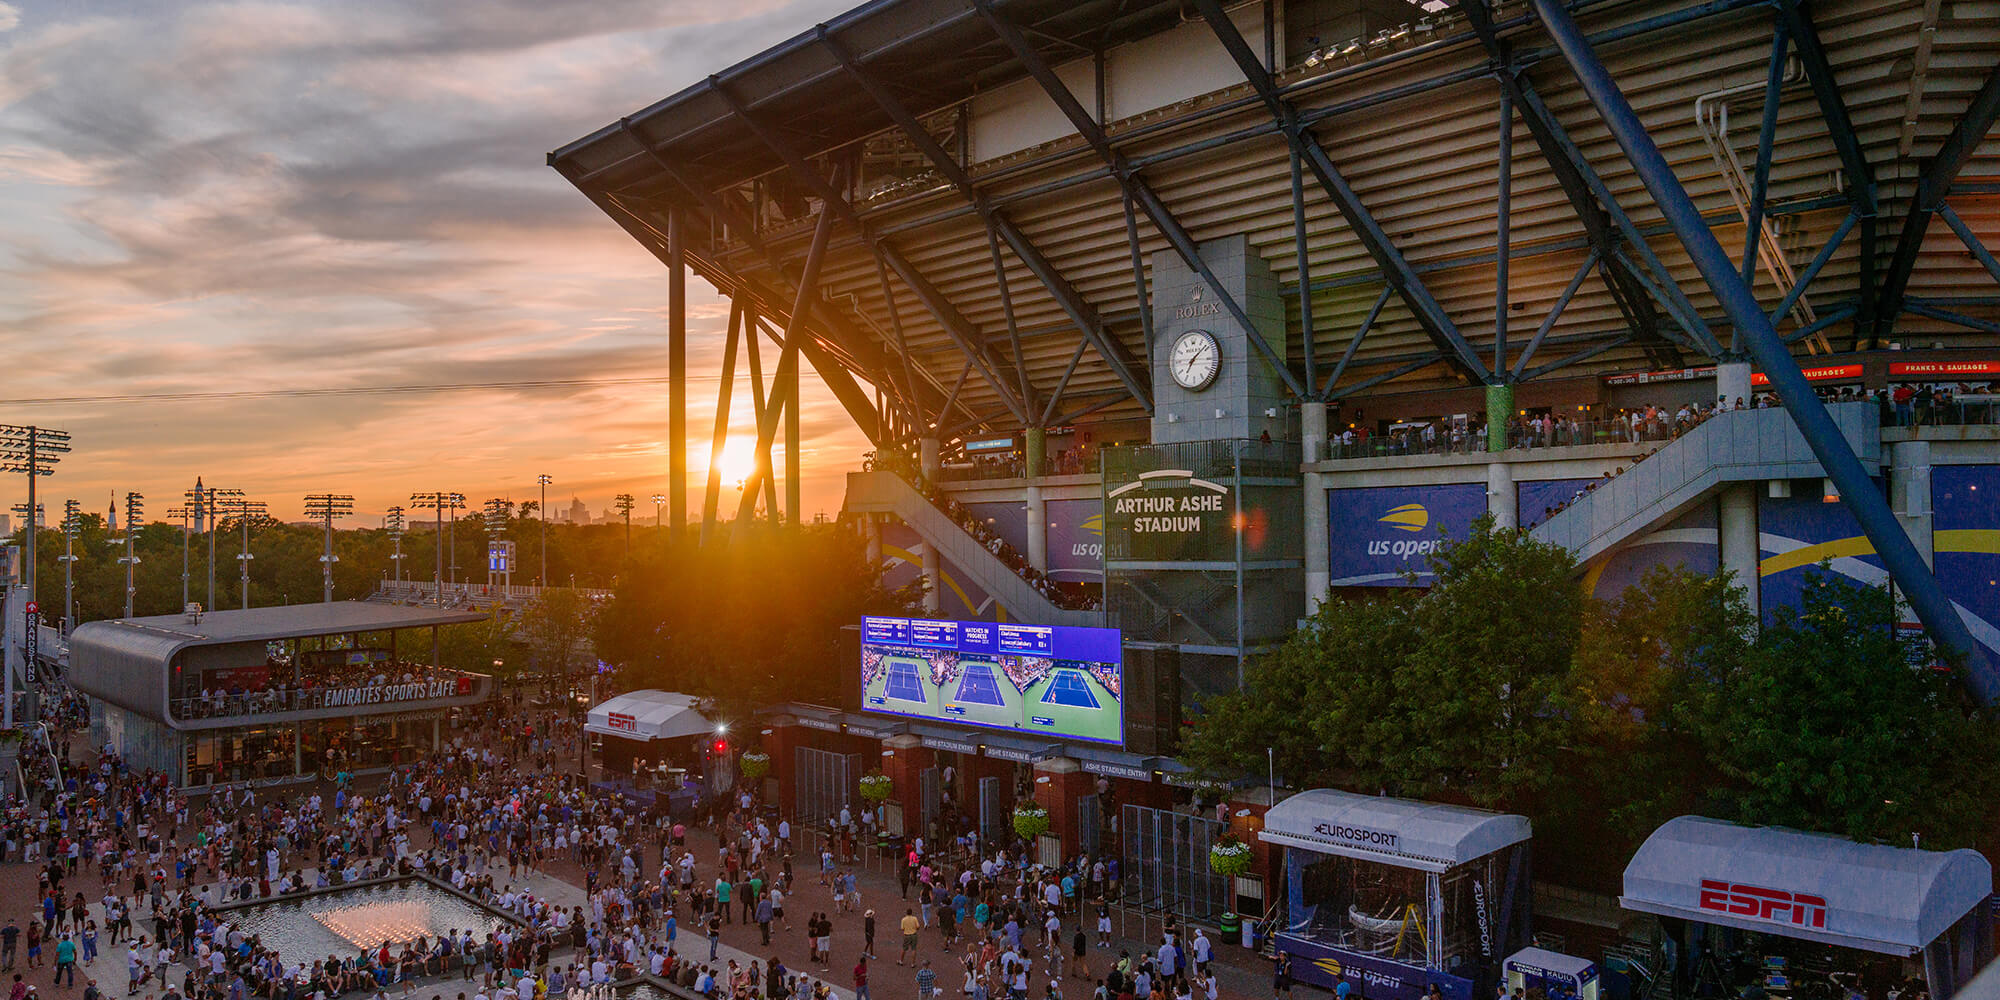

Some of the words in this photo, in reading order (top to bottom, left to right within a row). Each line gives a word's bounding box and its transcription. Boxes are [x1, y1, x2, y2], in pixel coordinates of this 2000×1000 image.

[1176, 303, 1220, 319] ROLEX
[1947, 363, 1988, 371] SAUSAGES
[1115, 497, 1175, 513] ARTHUR
[1180, 495, 1223, 511] ASHE
[1134, 516, 1200, 533] STADIUM
[1072, 544, 1088, 556] us
[1368, 540, 1390, 556] us
[1392, 540, 1442, 560] open
[28, 613, 36, 682] GRANDSTAND
[324, 686, 381, 708] EMIRATES
[384, 683, 427, 702] SPORTS
[429, 680, 456, 698] CAFE
[368, 715, 394, 727] open
[396, 711, 444, 722] collection
[608, 712, 637, 731] ESPN
[937, 740, 957, 749] STADIUM
[958, 744, 973, 752] ENTRY
[988, 748, 1002, 756] ASHE
[1002, 750, 1025, 760] STADIUM
[1085, 762, 1101, 771] ASHE
[1101, 765, 1126, 776] STADIUM
[1127, 769, 1147, 778] ENTRY
[1320, 823, 1397, 847] EUROSPORT
[1700, 880, 1826, 928] ESPN
[1474, 885, 1490, 957] EUROSPORT
[1345, 966, 1361, 978] us
[1364, 970, 1400, 988] open
[1547, 970, 1573, 981] RADIO
